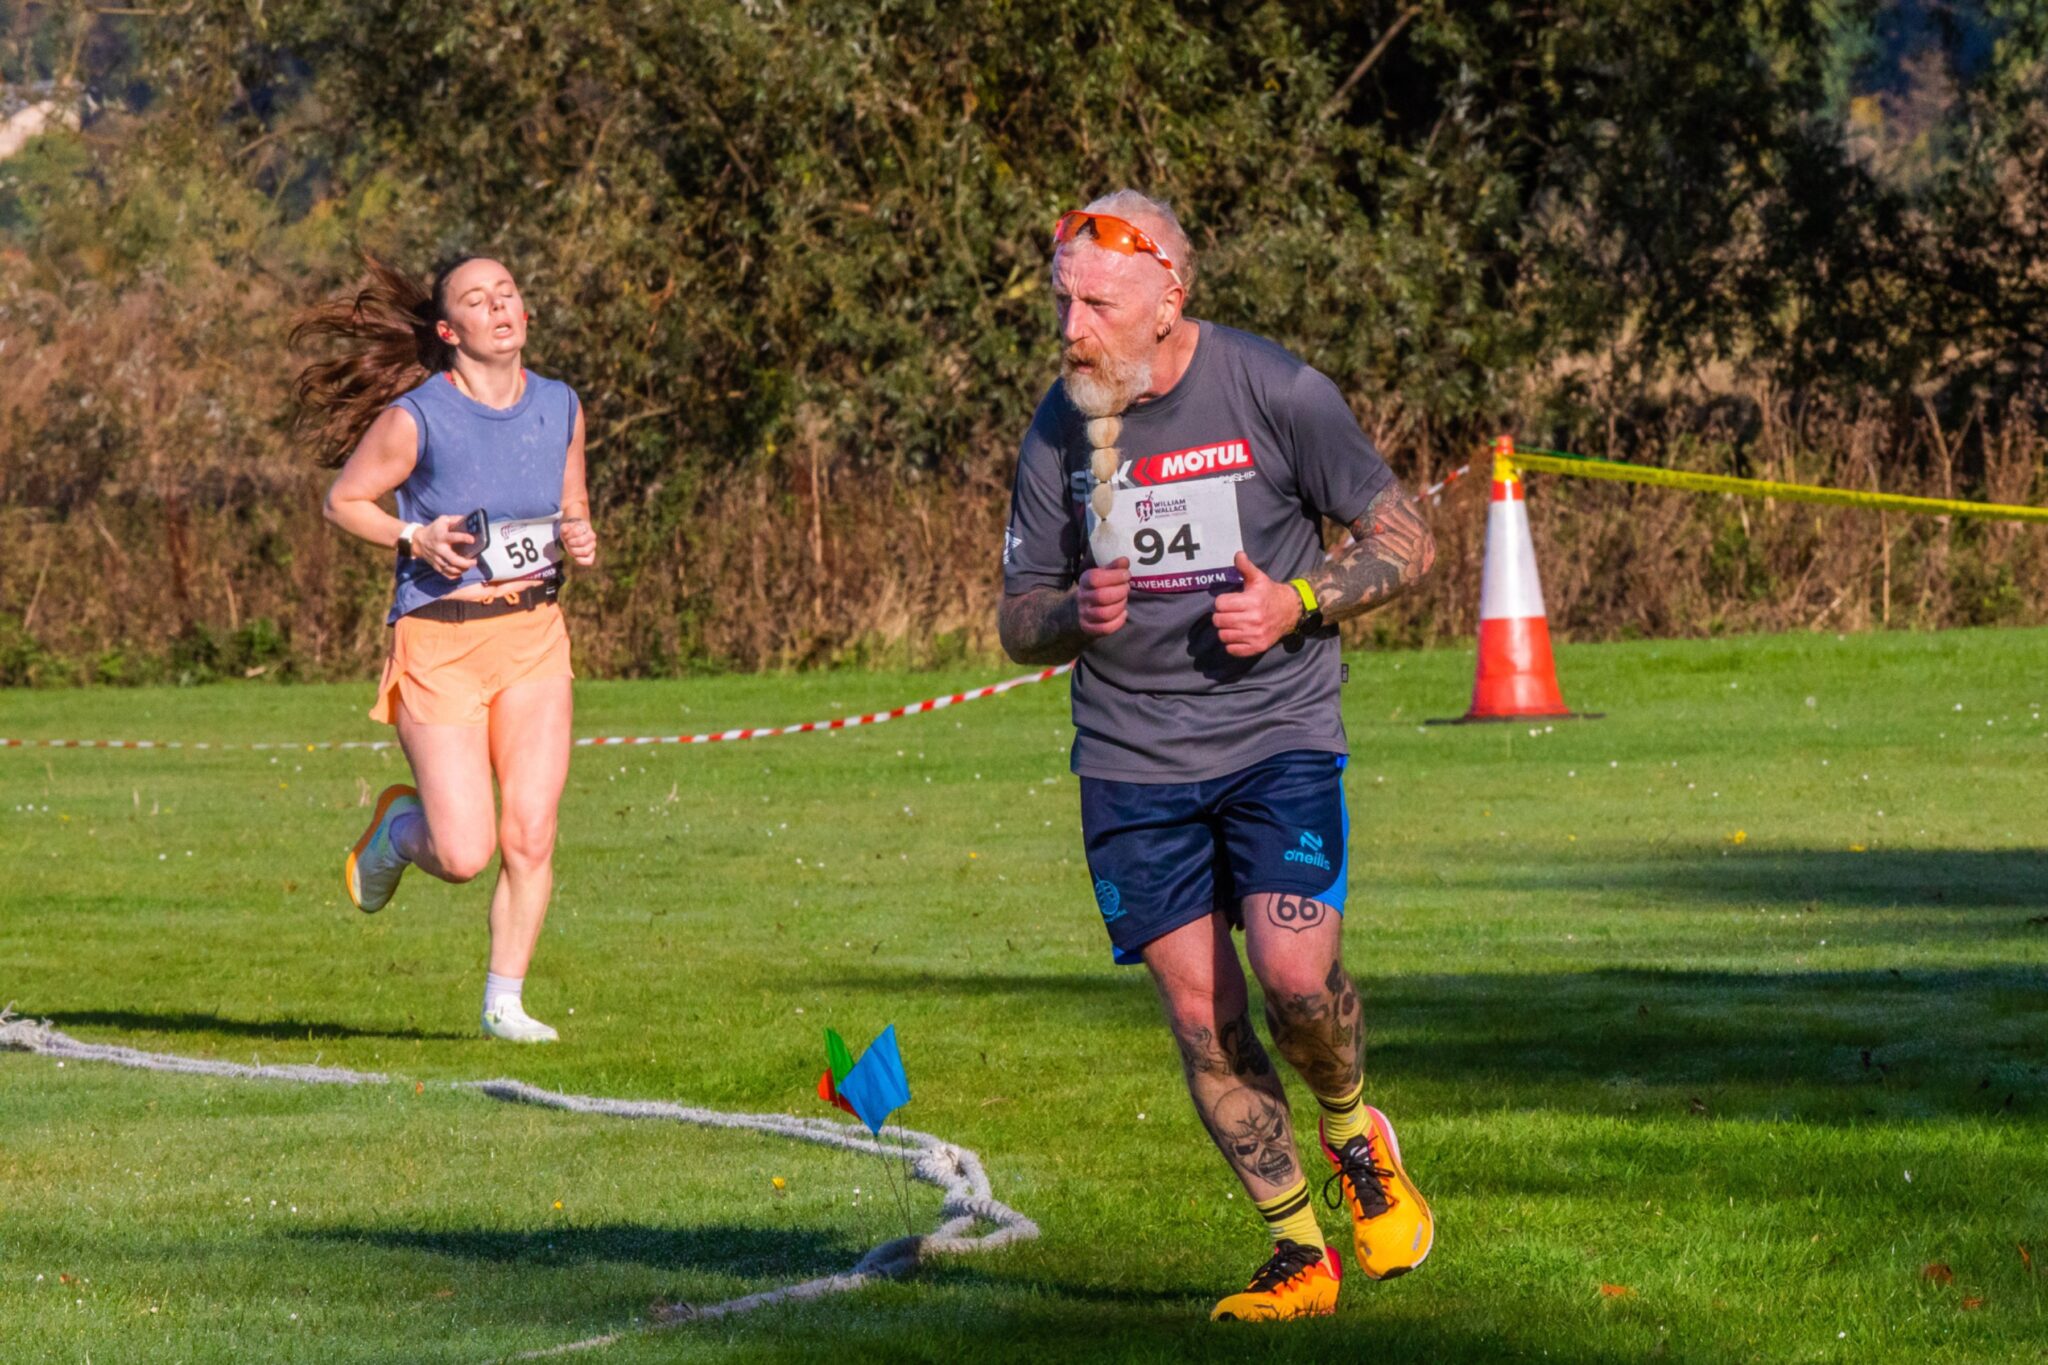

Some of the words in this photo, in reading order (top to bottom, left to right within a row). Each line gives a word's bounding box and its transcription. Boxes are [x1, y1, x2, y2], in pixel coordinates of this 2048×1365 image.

[1161, 443, 1248, 477] MOTUL
[1153, 498, 1187, 507] WILLIAM
[1154, 504, 1188, 513] WALLACE
[505, 537, 539, 569] 58
[1132, 523, 1201, 566] 94
[1130, 577, 1192, 590] RAVEHEART
[1195, 573, 1226, 584] 10KM
[1277, 894, 1318, 921] 66
